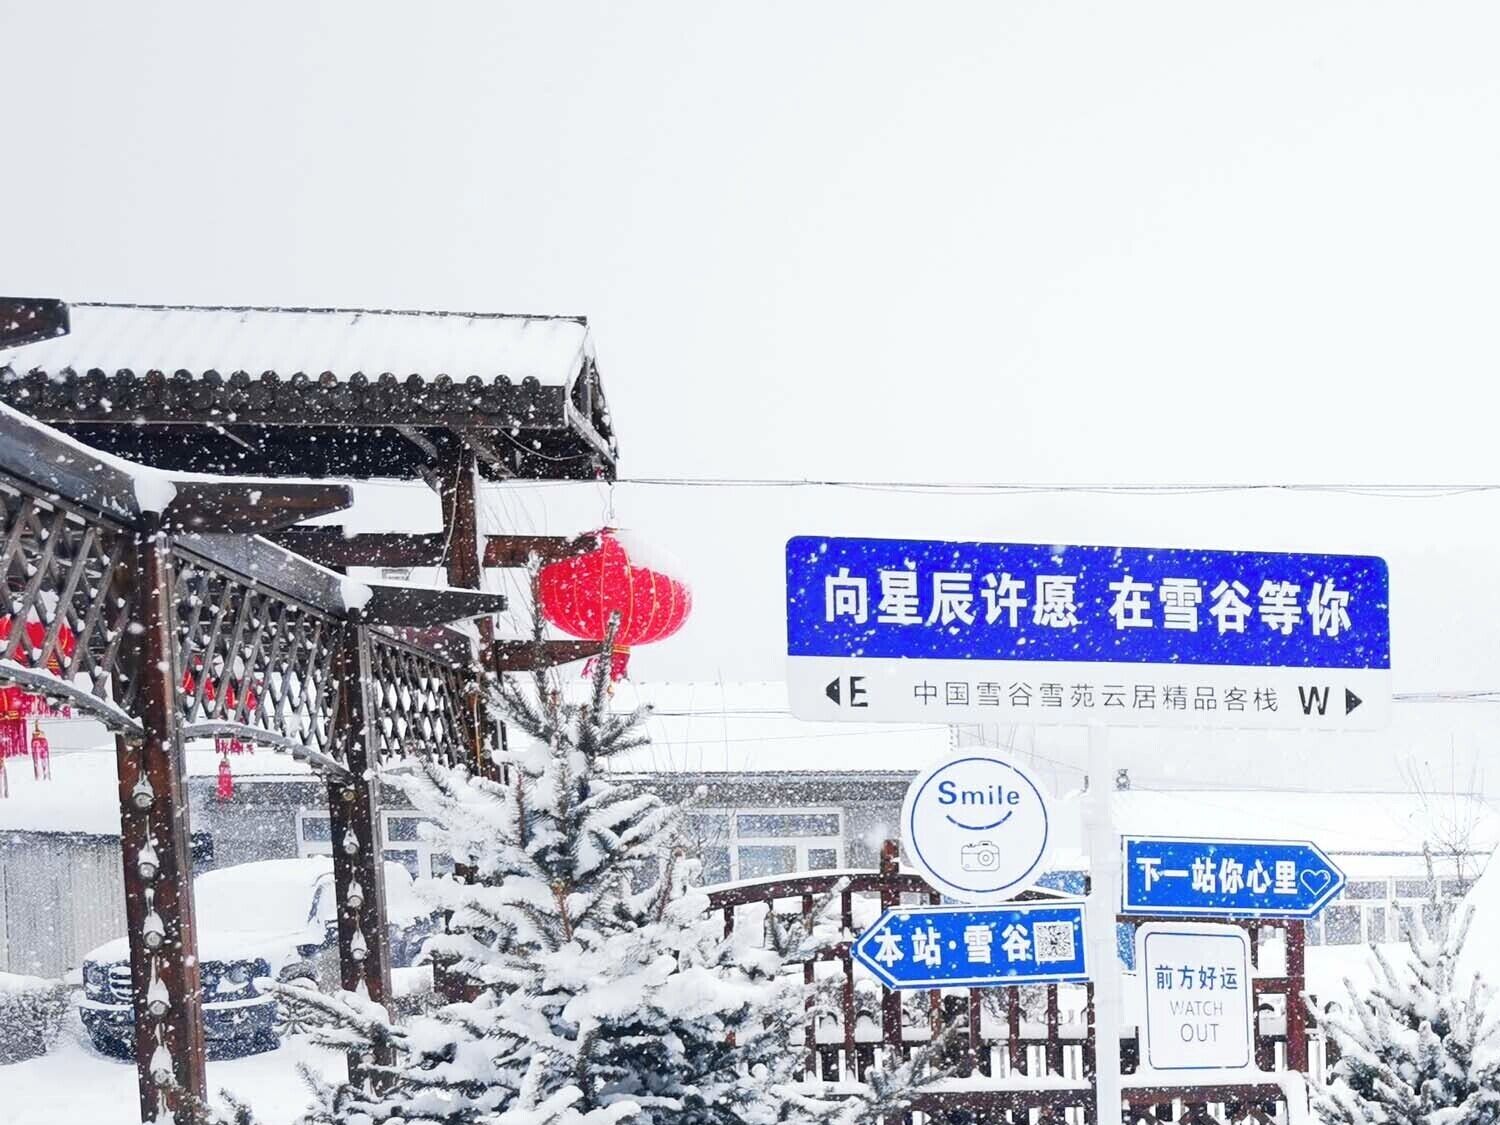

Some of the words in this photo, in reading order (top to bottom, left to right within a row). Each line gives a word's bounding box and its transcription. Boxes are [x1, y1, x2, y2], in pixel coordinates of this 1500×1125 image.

[823, 567, 1078, 630] 向星辰许愿
[1108, 573, 1352, 637] 在雪谷等你
[849, 675, 869, 708] E
[913, 680, 1279, 713] 中国雪谷雪苑云居精品客栈
[1297, 685, 1331, 717] W
[937, 780, 1020, 806] Smile
[1136, 857, 1298, 894] 下一站你心里
[1154, 964, 1239, 991] 前方好运
[1169, 999, 1224, 1017] WATCH
[1180, 1022, 1220, 1043] OUT
